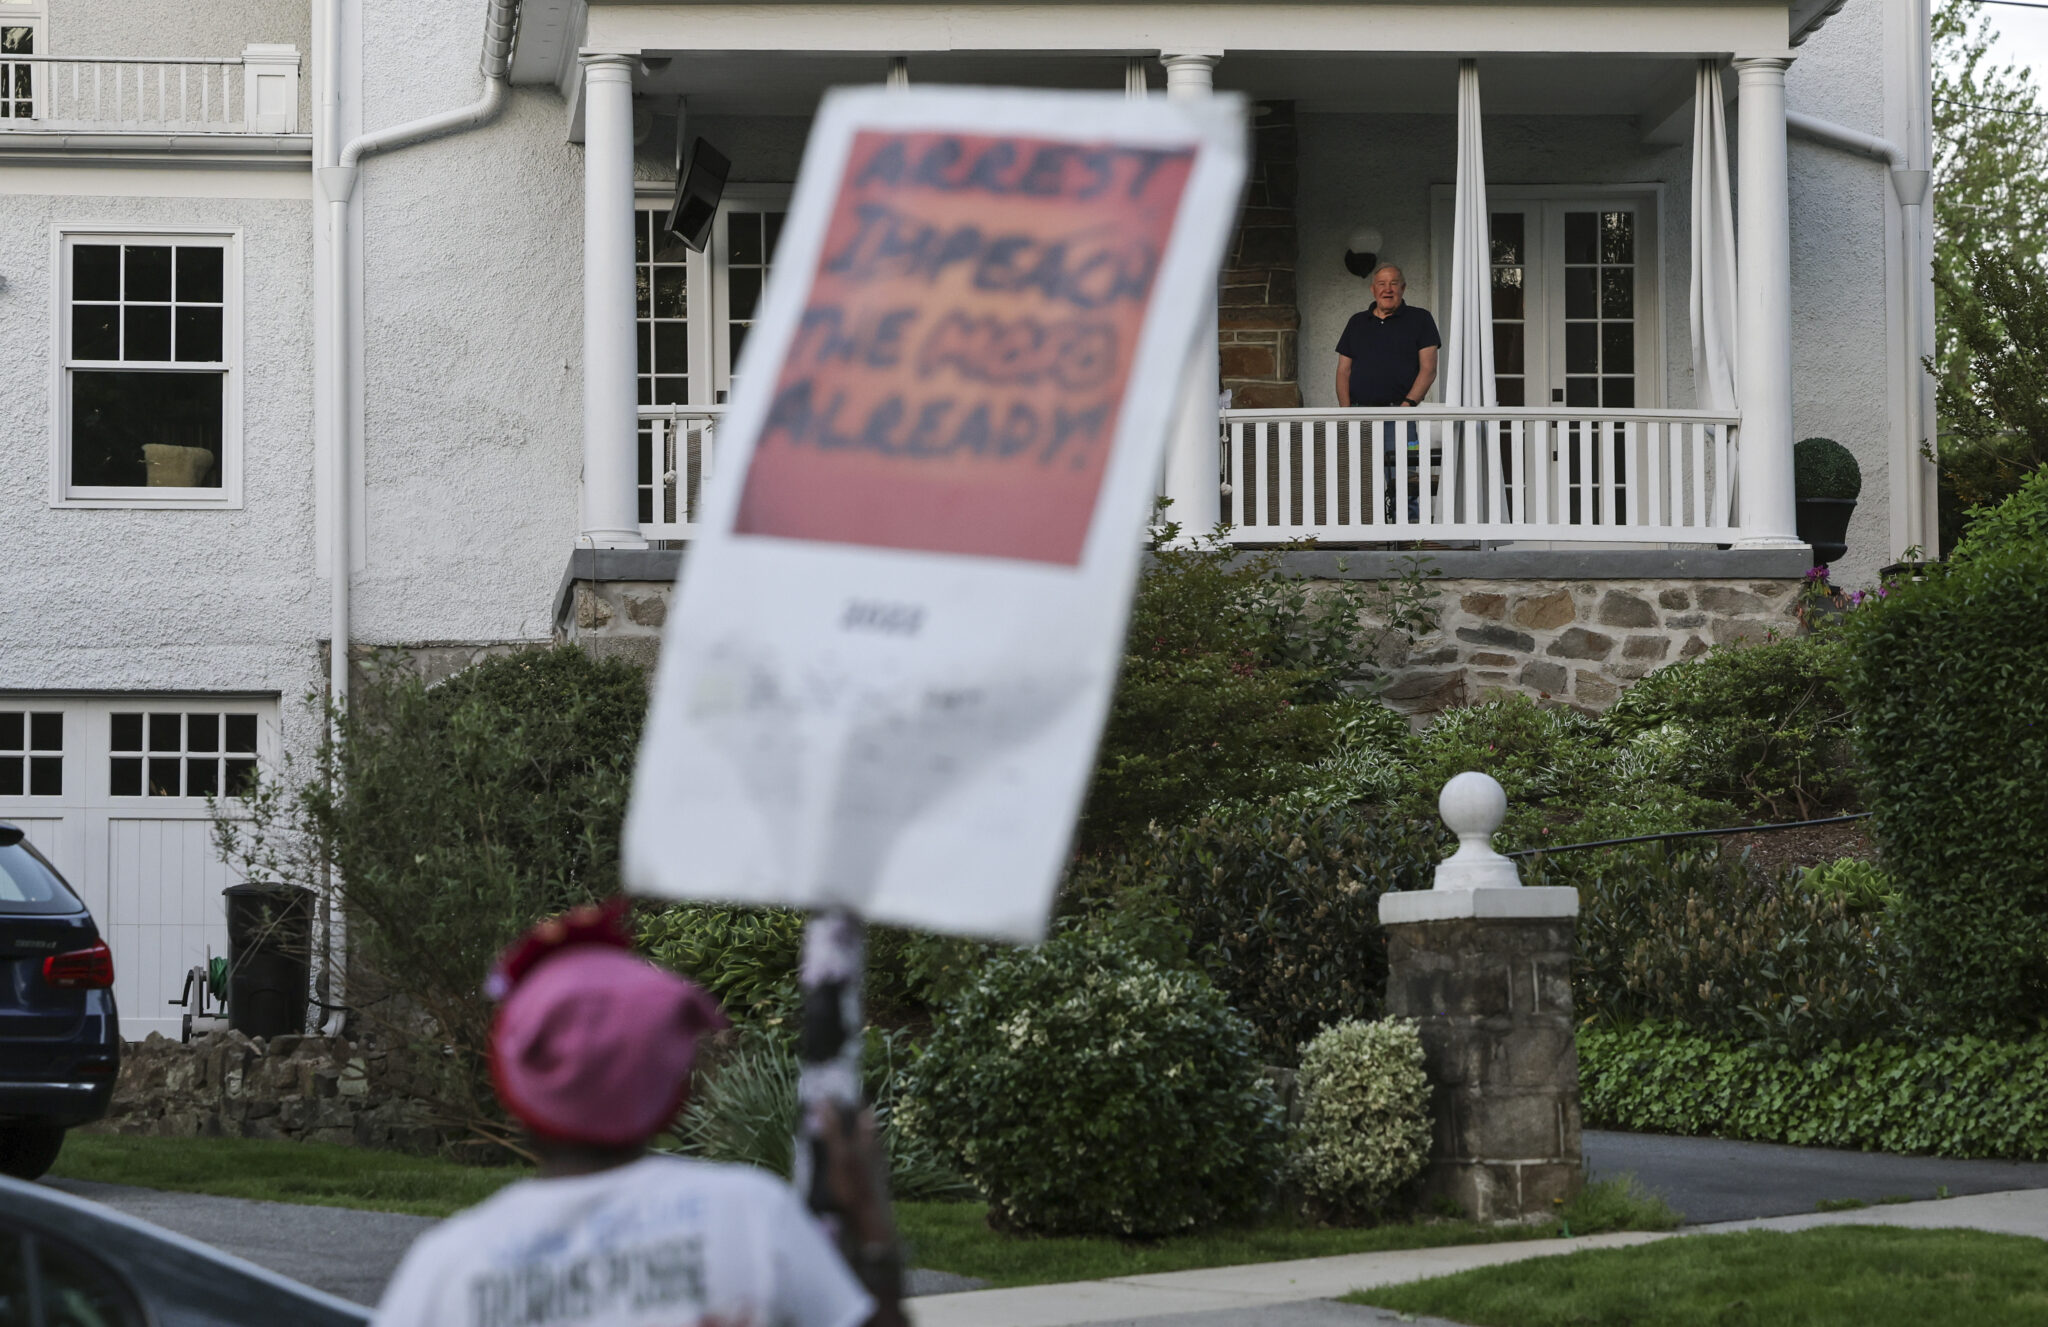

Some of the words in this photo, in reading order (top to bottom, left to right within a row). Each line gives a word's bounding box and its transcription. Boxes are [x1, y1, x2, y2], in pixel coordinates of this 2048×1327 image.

[852, 133, 1192, 202] ARREST
[822, 200, 1160, 310] IMPEACH
[796, 305, 918, 370] THE
[764, 374, 1110, 471] ALREADY!
